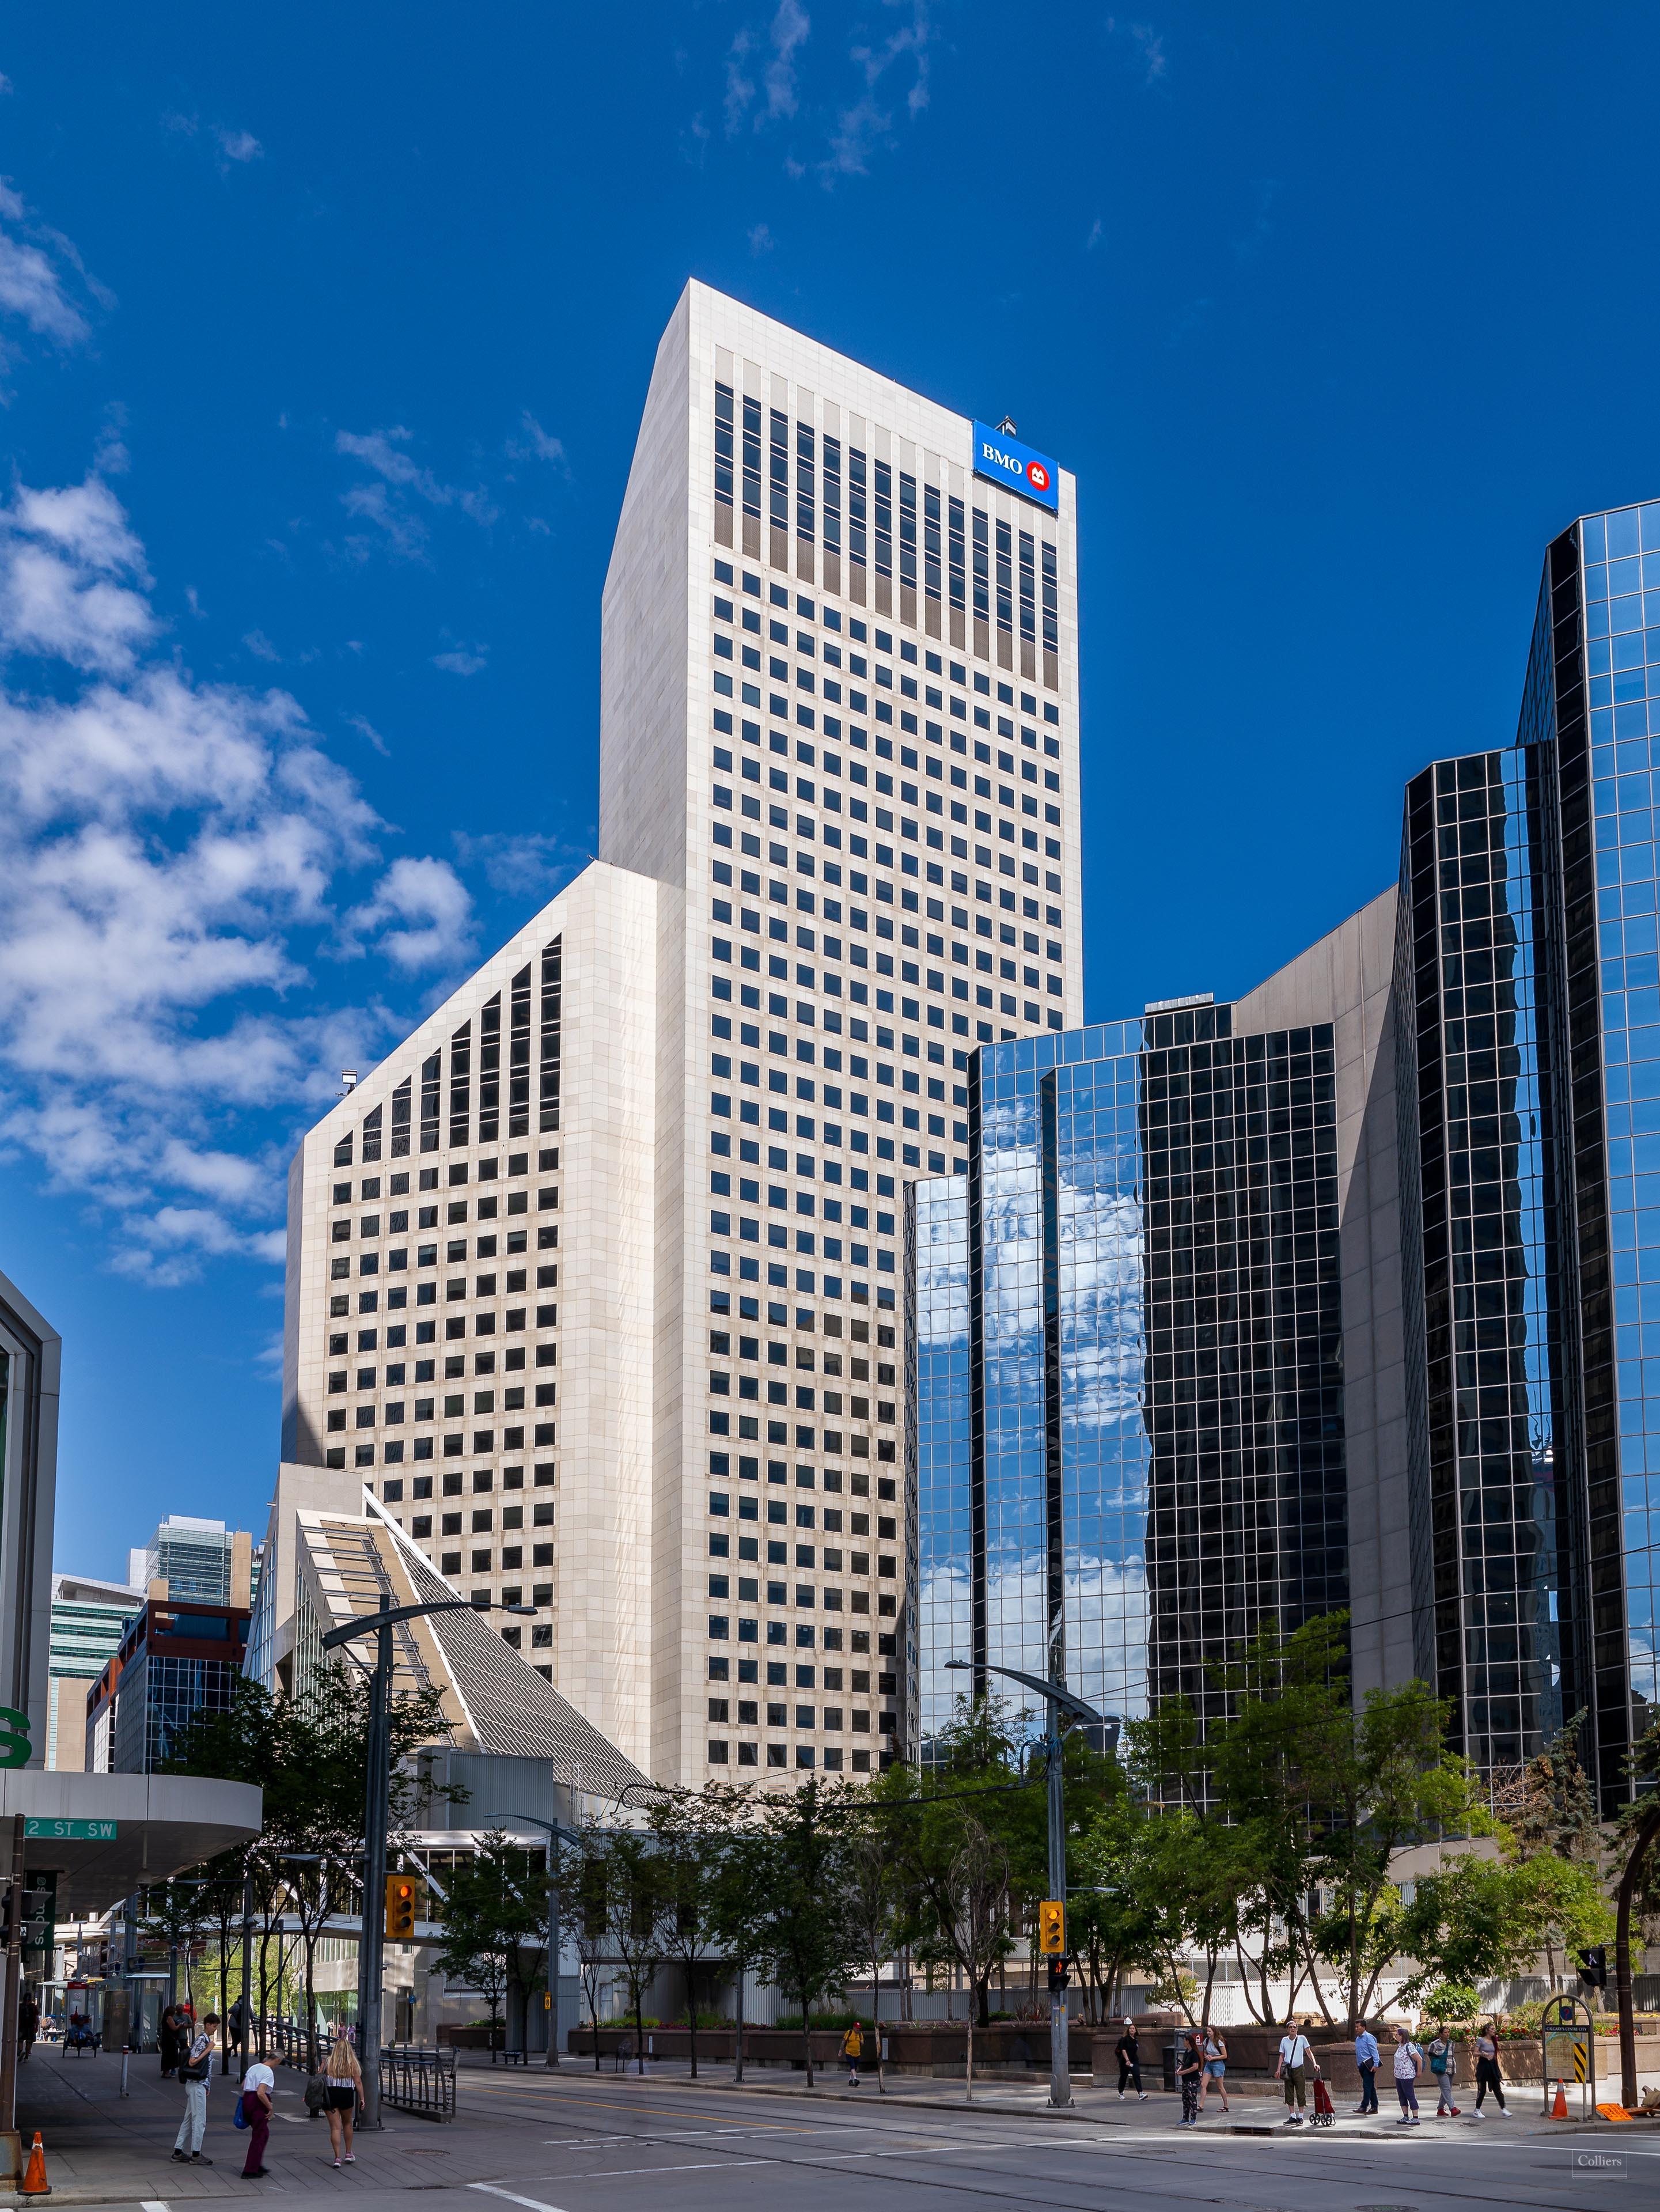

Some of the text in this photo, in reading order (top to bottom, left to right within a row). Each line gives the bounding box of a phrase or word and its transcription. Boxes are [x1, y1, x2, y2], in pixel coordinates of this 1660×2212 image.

[982, 442, 1023, 475] BMO
[28, 1820, 113, 1837] 2 ST SW
